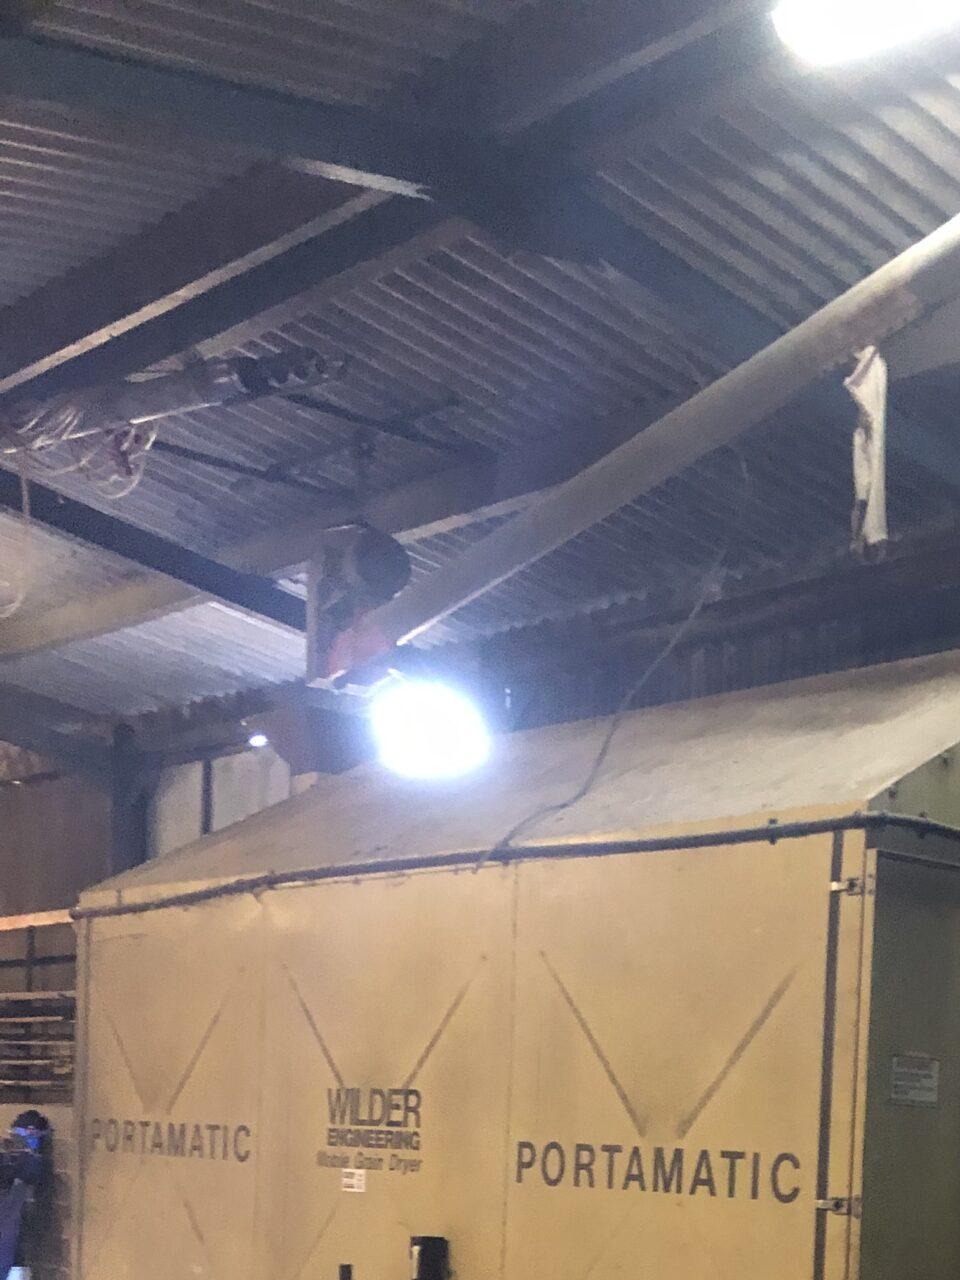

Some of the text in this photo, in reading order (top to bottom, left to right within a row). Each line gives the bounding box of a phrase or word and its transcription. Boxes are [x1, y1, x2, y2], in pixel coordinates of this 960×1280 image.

[327, 1087, 421, 1128] WILDER
[93, 1118, 251, 1162] PORTAMATIC
[327, 1128, 420, 1150] ENGINEERING
[389, 1153, 422, 1175] Dryer
[516, 1141, 801, 1203] PORTAMATIC
